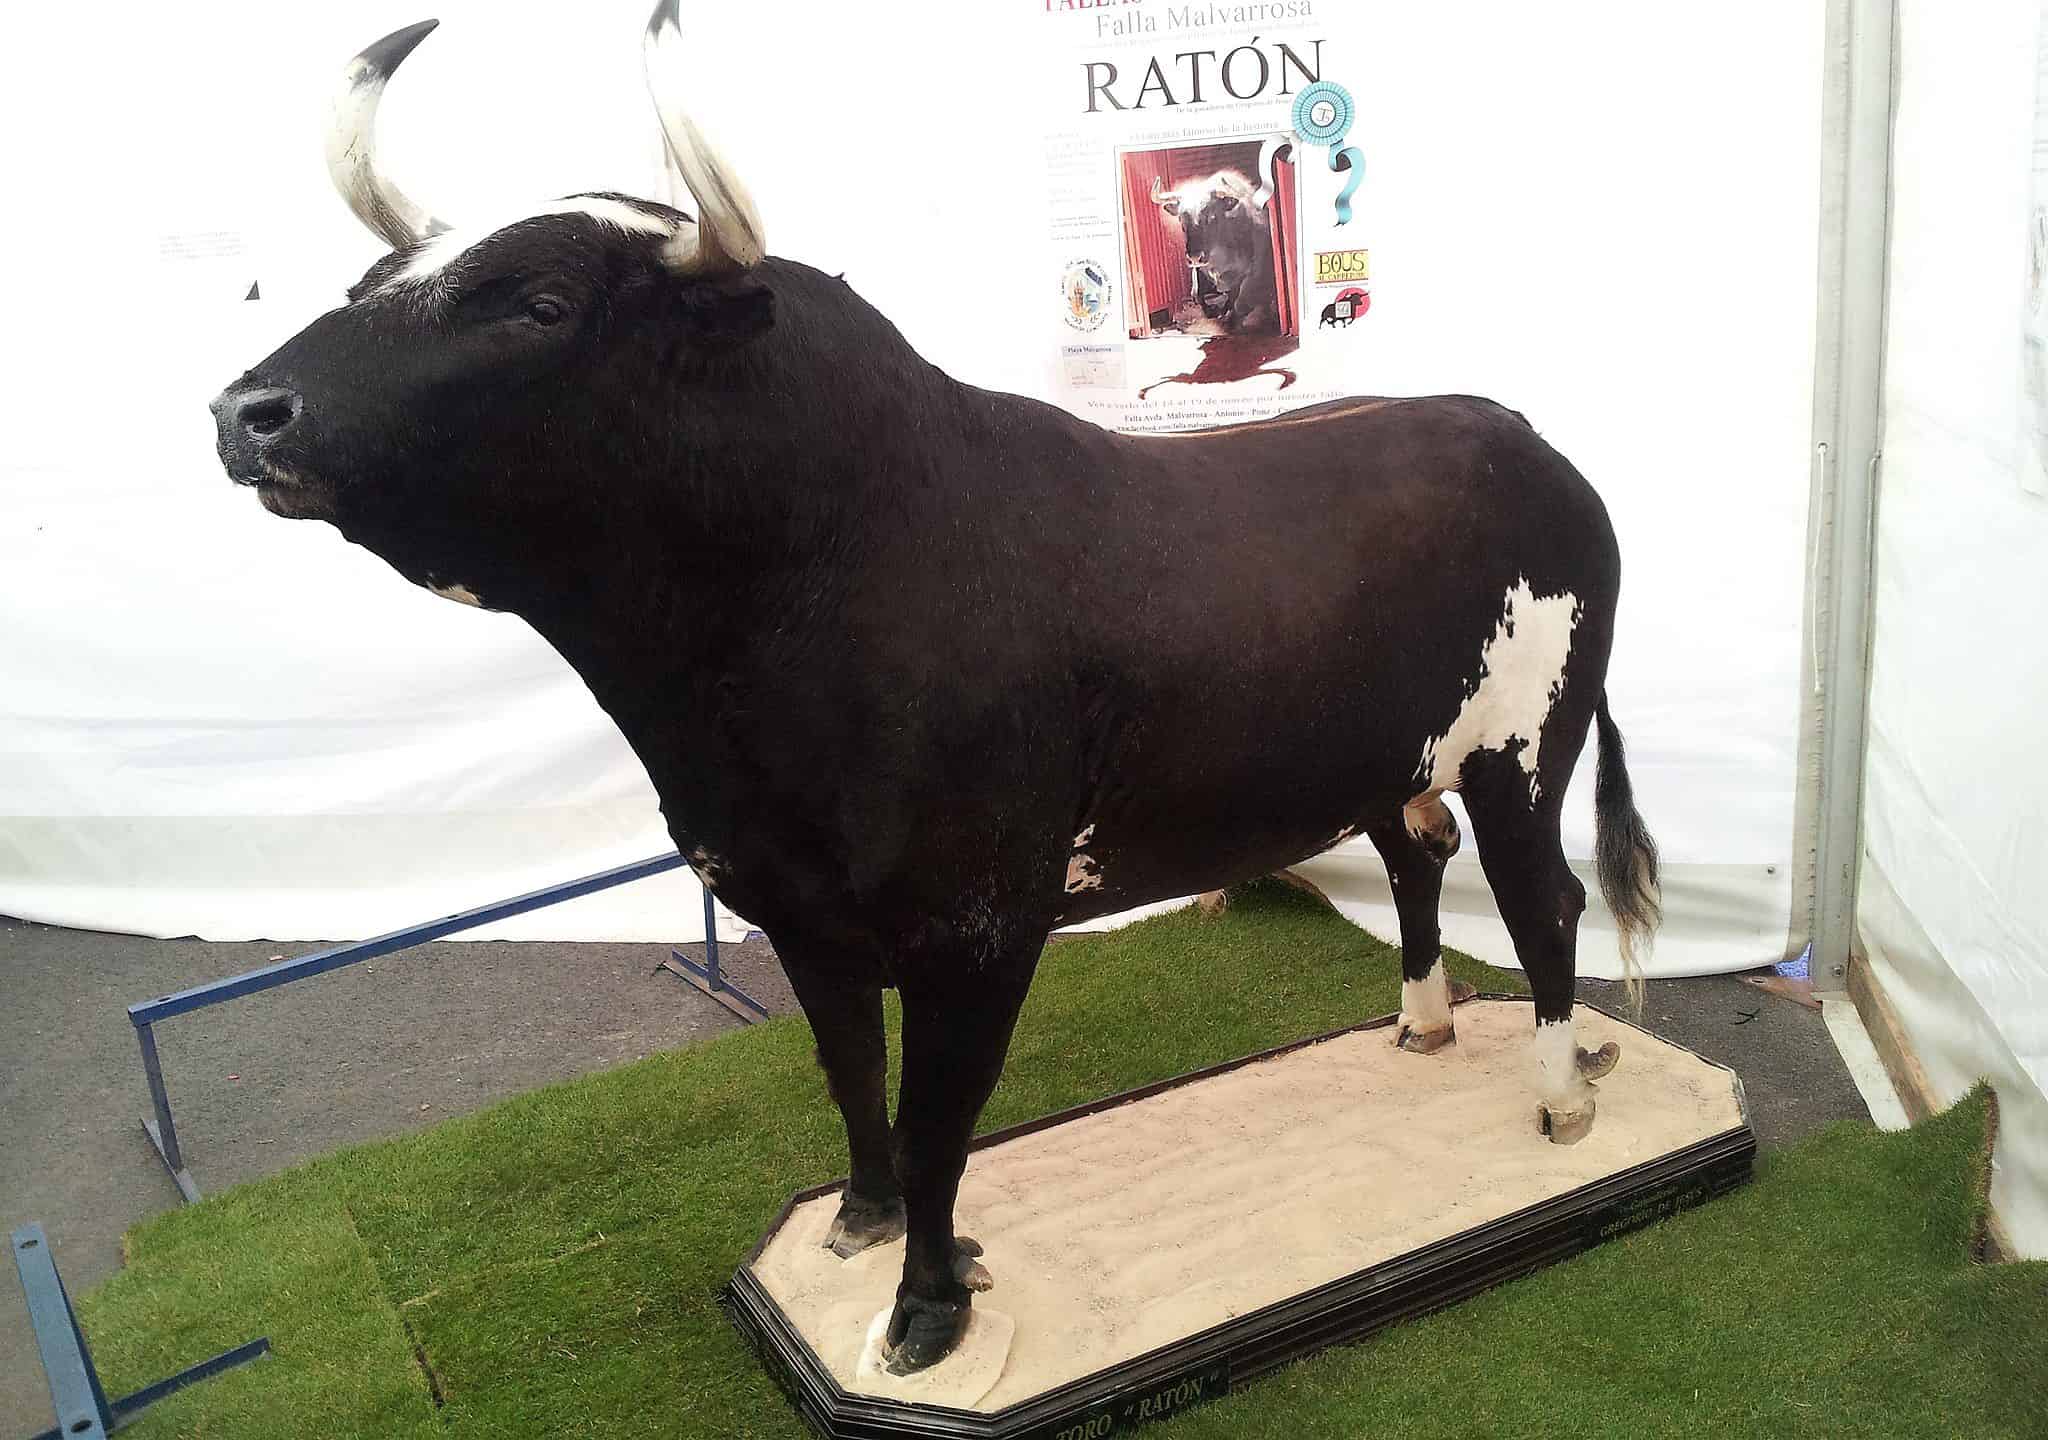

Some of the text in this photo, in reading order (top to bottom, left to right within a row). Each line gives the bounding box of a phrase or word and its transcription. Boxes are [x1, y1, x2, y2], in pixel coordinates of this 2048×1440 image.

[1096, 10, 1157, 38] Falla
[1167, 0, 1313, 31] Malvarrosa
[1080, 36, 1327, 113] RATÓN
[1319, 252, 1365, 274] BOUS
